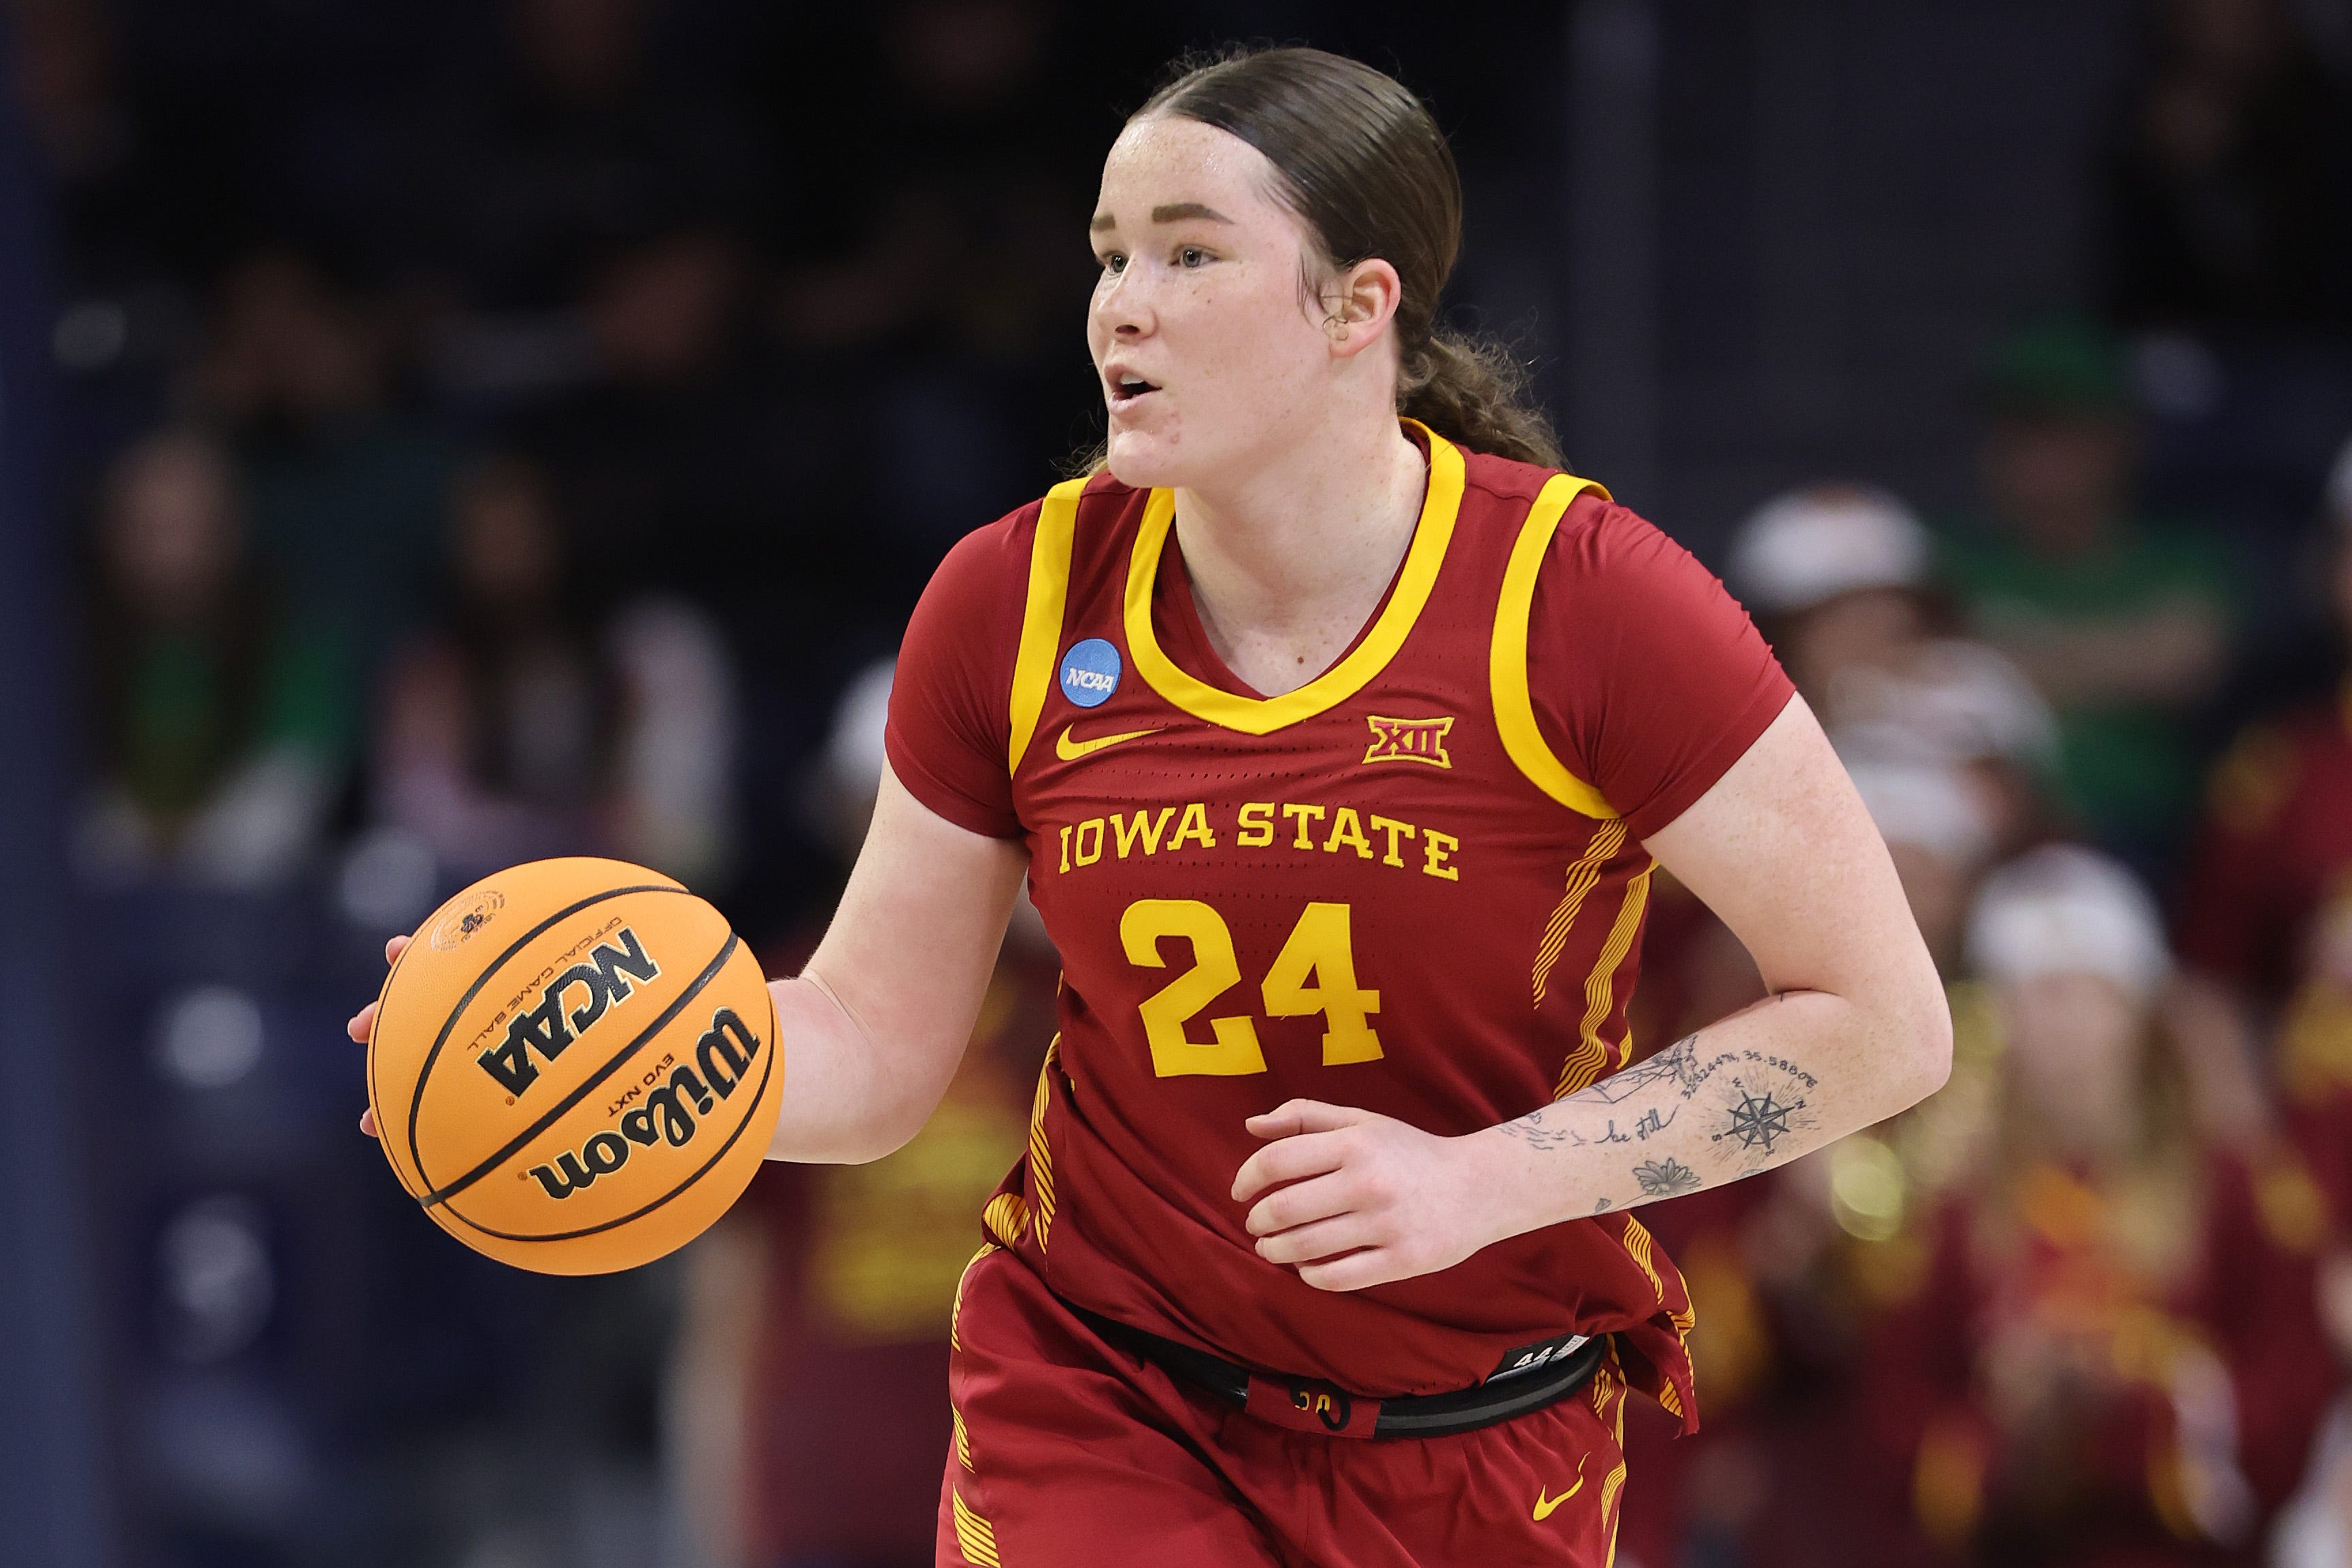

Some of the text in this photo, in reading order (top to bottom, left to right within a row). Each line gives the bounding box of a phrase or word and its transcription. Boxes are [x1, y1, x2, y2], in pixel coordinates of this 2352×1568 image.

[1065, 667, 1115, 693] NCAA
[1369, 720, 1446, 761] XII
[1058, 802, 1460, 881] IOWA STATE
[554, 917, 622, 964] OFFICIAL
[507, 966, 554, 1011] GAME
[1119, 898, 1385, 1078] 24
[467, 1010, 507, 1051] BALL
[475, 925, 662, 1099] NCAA
[526, 1006, 761, 1200] Wilson
[608, 1052, 675, 1118] EVO NXT
[1594, 1119, 1632, 1144] be
